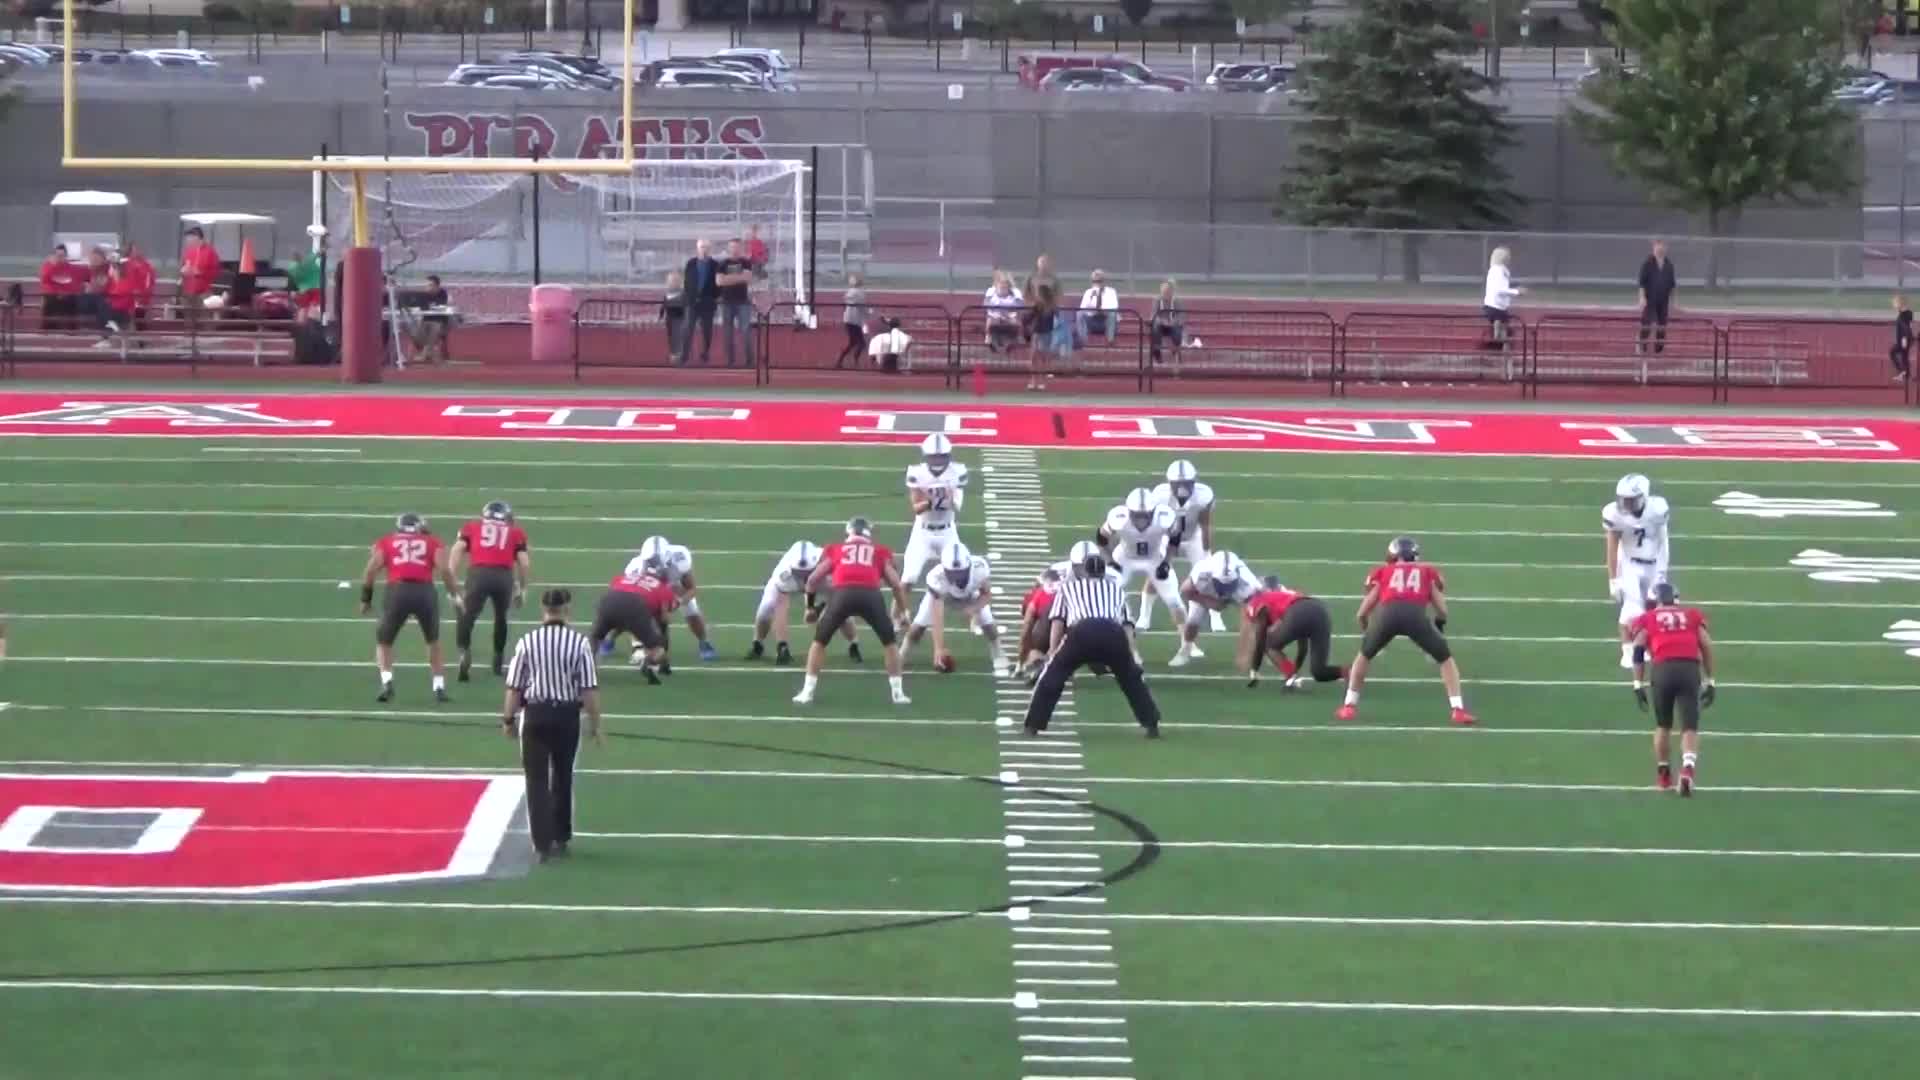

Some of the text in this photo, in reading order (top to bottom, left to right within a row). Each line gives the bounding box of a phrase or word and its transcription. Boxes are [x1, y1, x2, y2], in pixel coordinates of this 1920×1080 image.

[480, 523, 510, 550] 91
[1632, 527, 1646, 548] 7
[392, 539, 428, 566] 32
[841, 544, 875, 567] 30
[1388, 567, 1421, 594] 44
